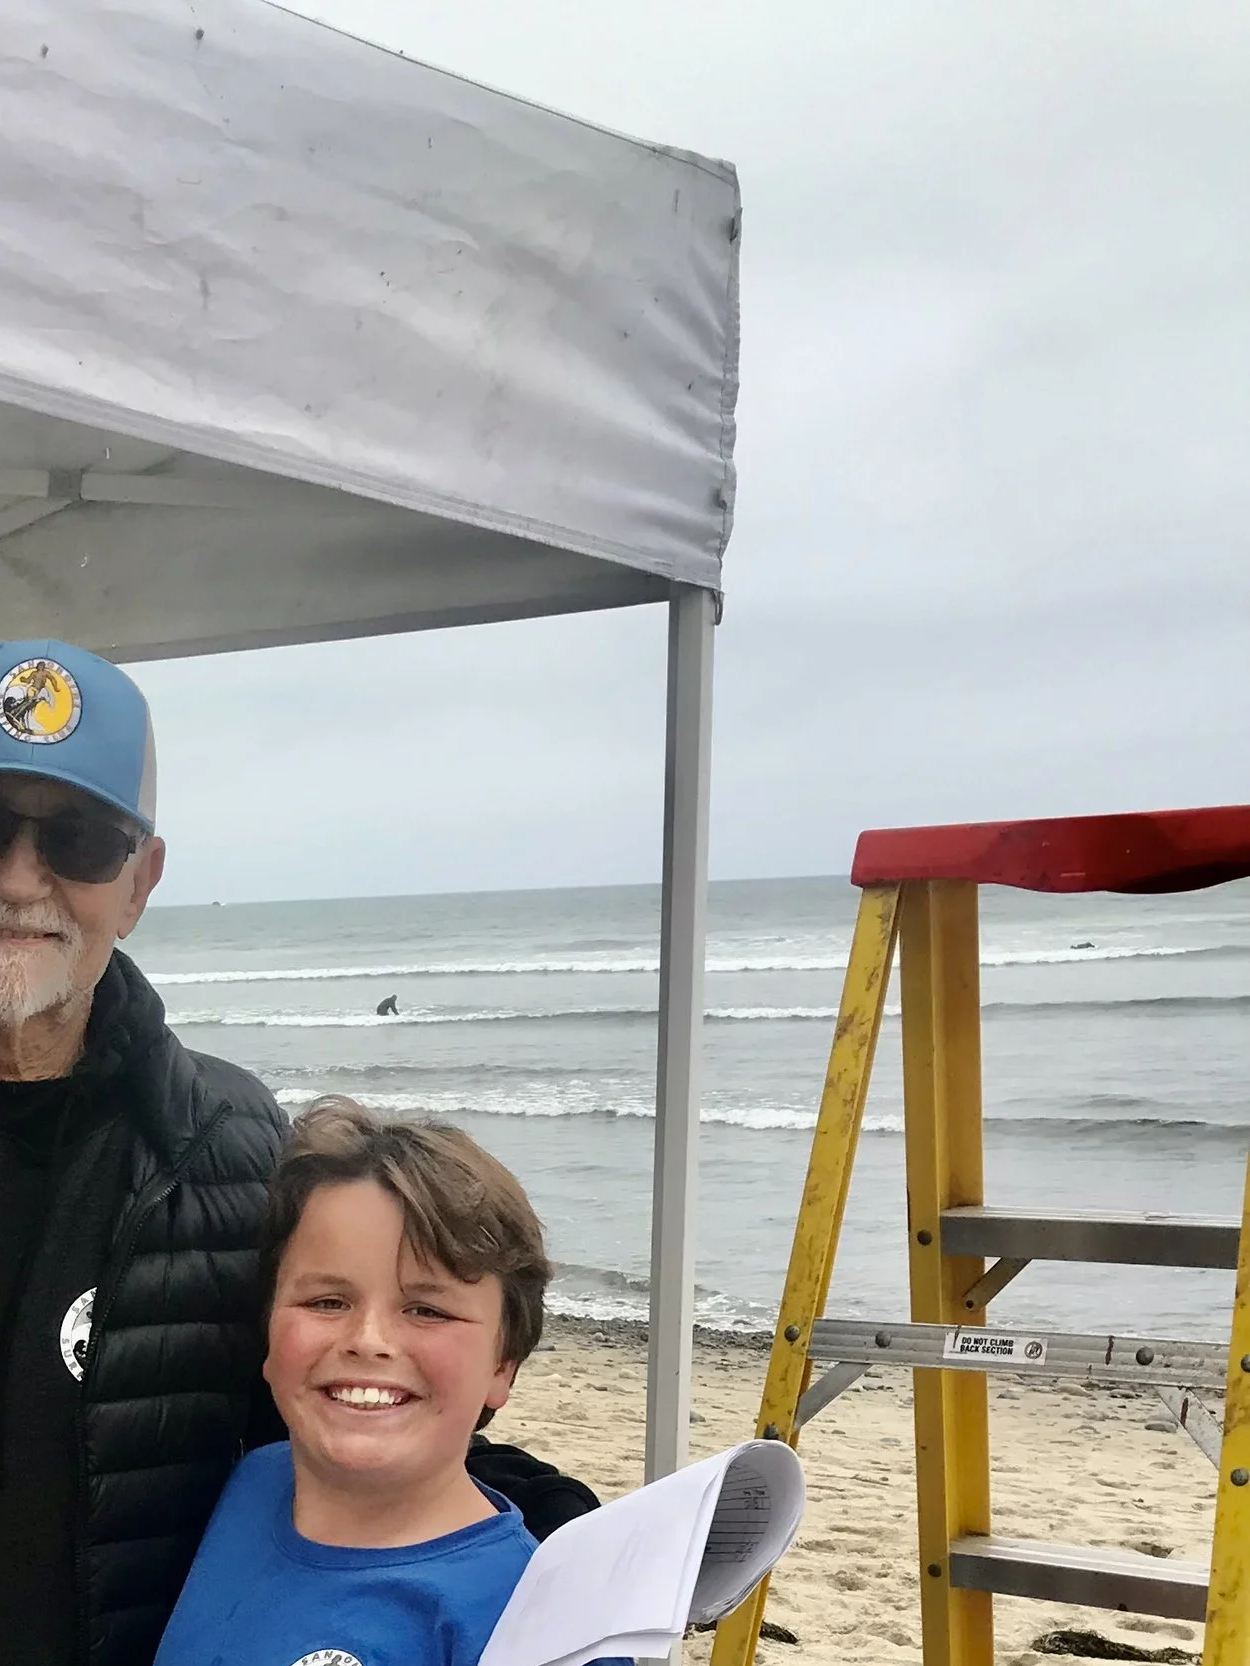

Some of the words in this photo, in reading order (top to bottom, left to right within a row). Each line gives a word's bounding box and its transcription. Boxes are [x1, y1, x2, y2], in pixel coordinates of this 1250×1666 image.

[8, 660, 36, 679] SAN
[961, 1336, 972, 1345] DO
[973, 1337, 988, 1346] NOT
[990, 1338, 1014, 1348] CLIMB
[960, 1345, 980, 1353] BACK
[981, 1345, 1014, 1355] SECTION
[301, 1650, 334, 1666] SAN
